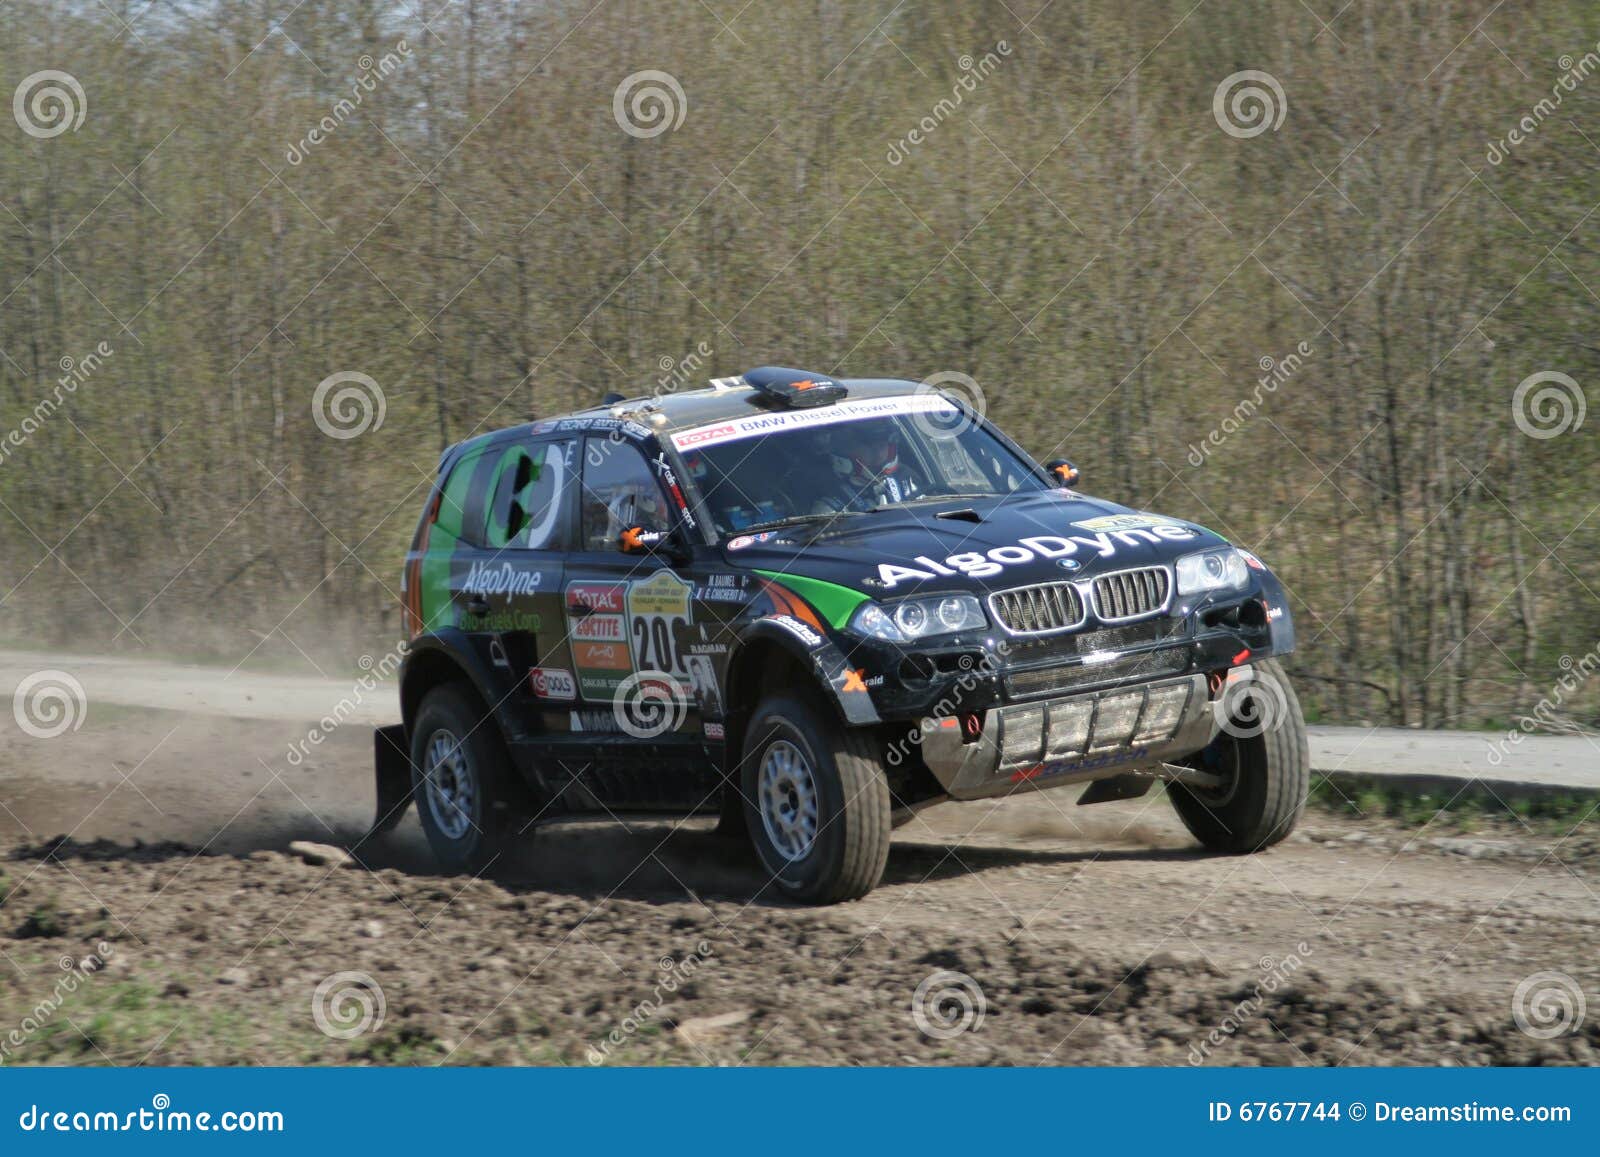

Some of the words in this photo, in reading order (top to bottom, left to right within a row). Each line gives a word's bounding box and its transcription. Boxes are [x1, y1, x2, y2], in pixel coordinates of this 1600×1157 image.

[679, 427, 735, 445] TOTAL
[741, 416, 785, 432] BMW
[791, 405, 845, 422] Diesel
[847, 402, 898, 415] Power
[877, 525, 1195, 588] AlgoDyne
[462, 561, 541, 604] AlgoDyne
[574, 588, 617, 608] TOTAL
[704, 723, 724, 736] BBS
